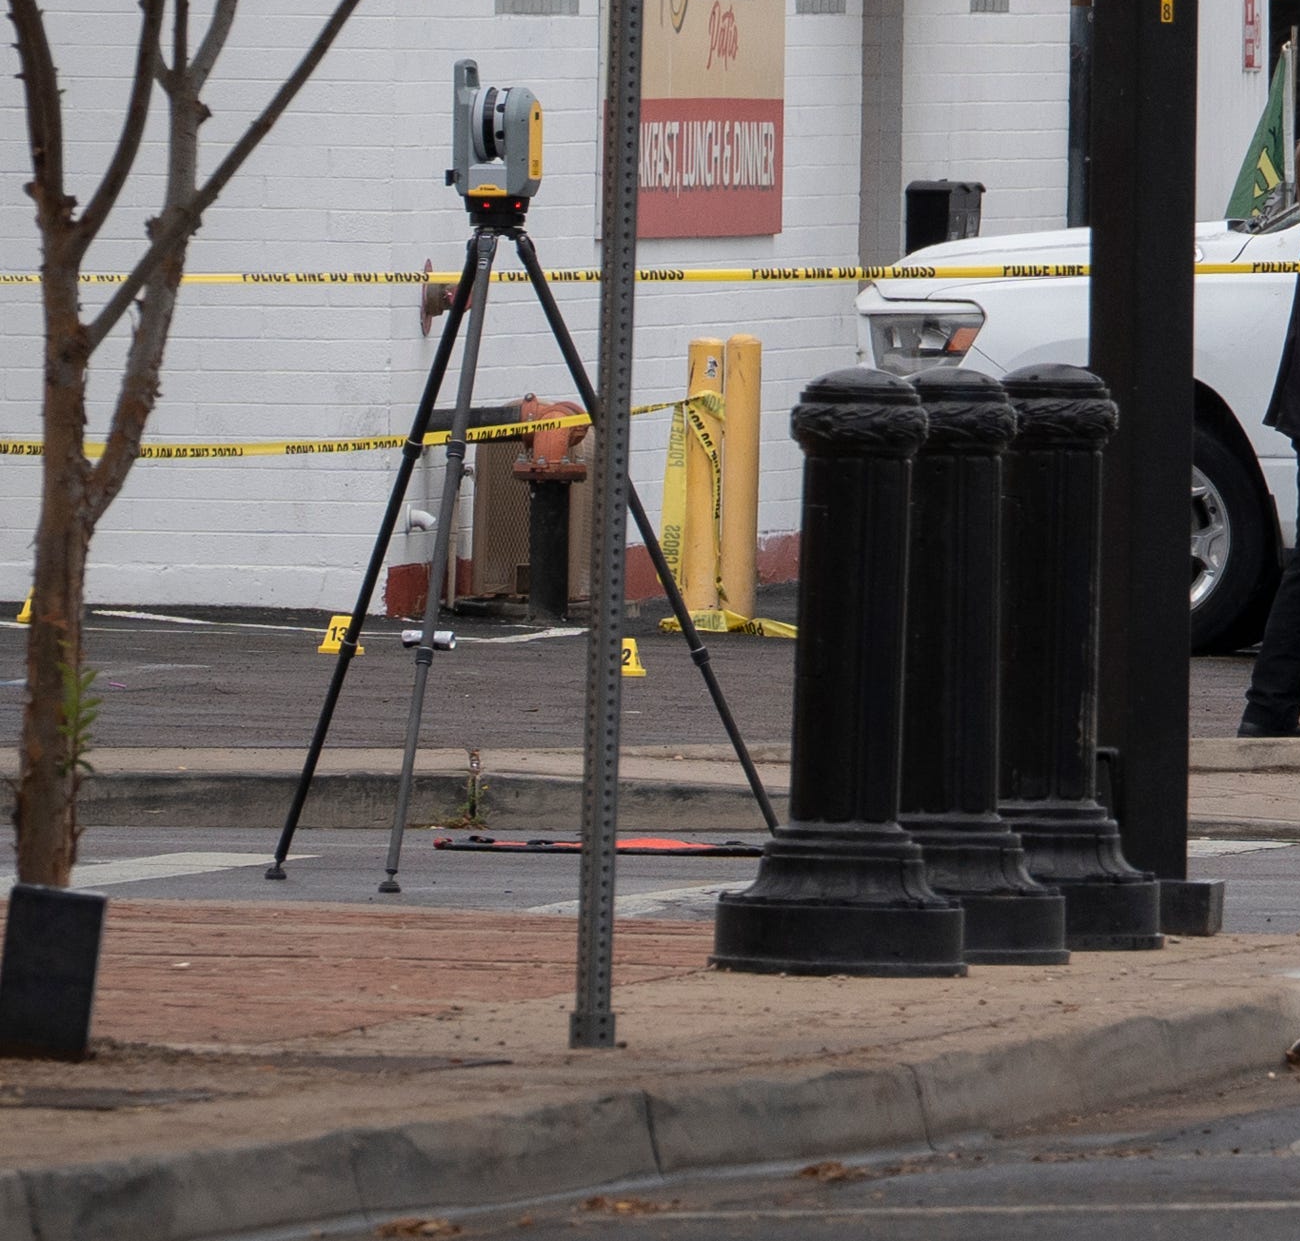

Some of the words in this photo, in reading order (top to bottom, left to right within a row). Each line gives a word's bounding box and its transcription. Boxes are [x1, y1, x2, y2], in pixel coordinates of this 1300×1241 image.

[706, 0, 739, 71] Patio
[682, 120, 721, 187] LUNCH
[723, 120, 731, 187] &
[733, 121, 775, 188] DINNER
[1003, 265, 1050, 277] POLICE
[1055, 264, 1084, 276] LINE
[1252, 261, 1299, 273] POLICE
[330, 626, 347, 642] 13
[622, 648, 631, 665] 2
